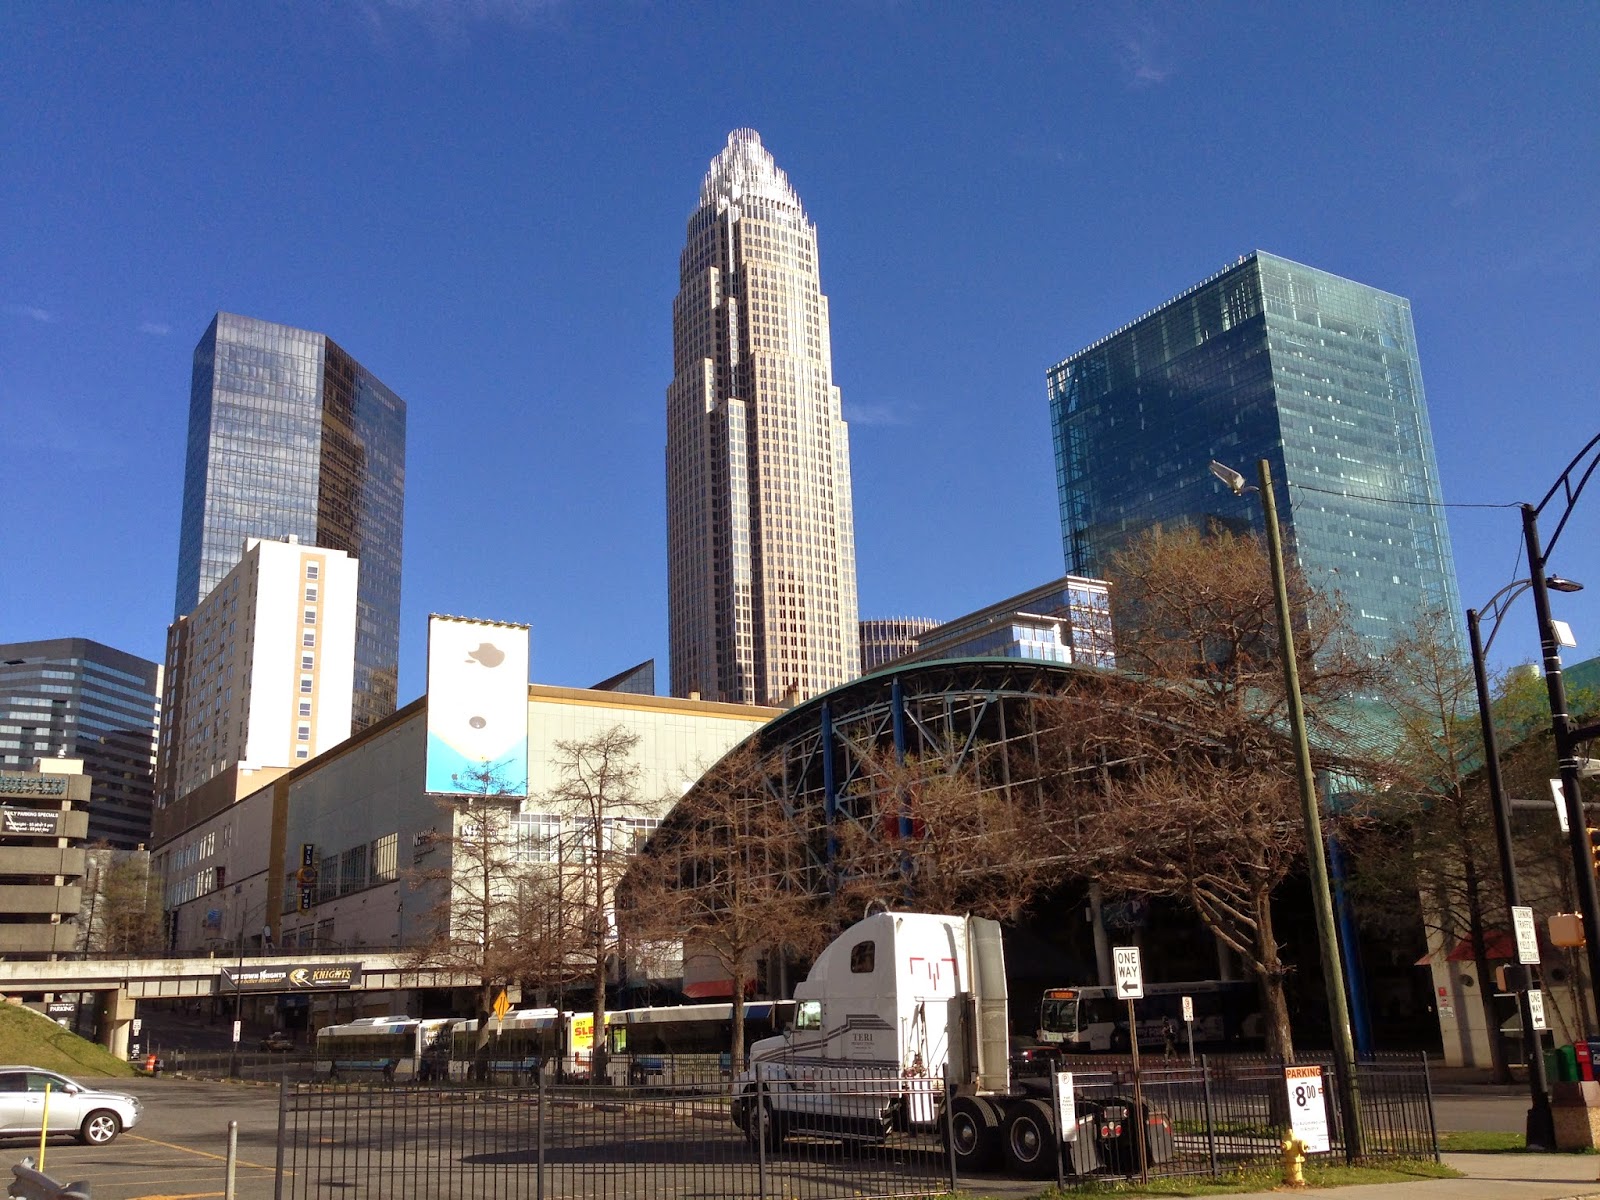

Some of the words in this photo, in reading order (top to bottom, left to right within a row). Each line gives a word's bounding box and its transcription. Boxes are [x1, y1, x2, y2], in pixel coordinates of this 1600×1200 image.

[1118, 952, 1136, 964] ONE
[312, 970, 352, 981] KNIGHTS
[1118, 966, 1138, 978] WAY
[1530, 992, 1540, 1002] ONE
[1532, 1004, 1542, 1013] WAY
[1286, 1068, 1321, 1078] PARKING
